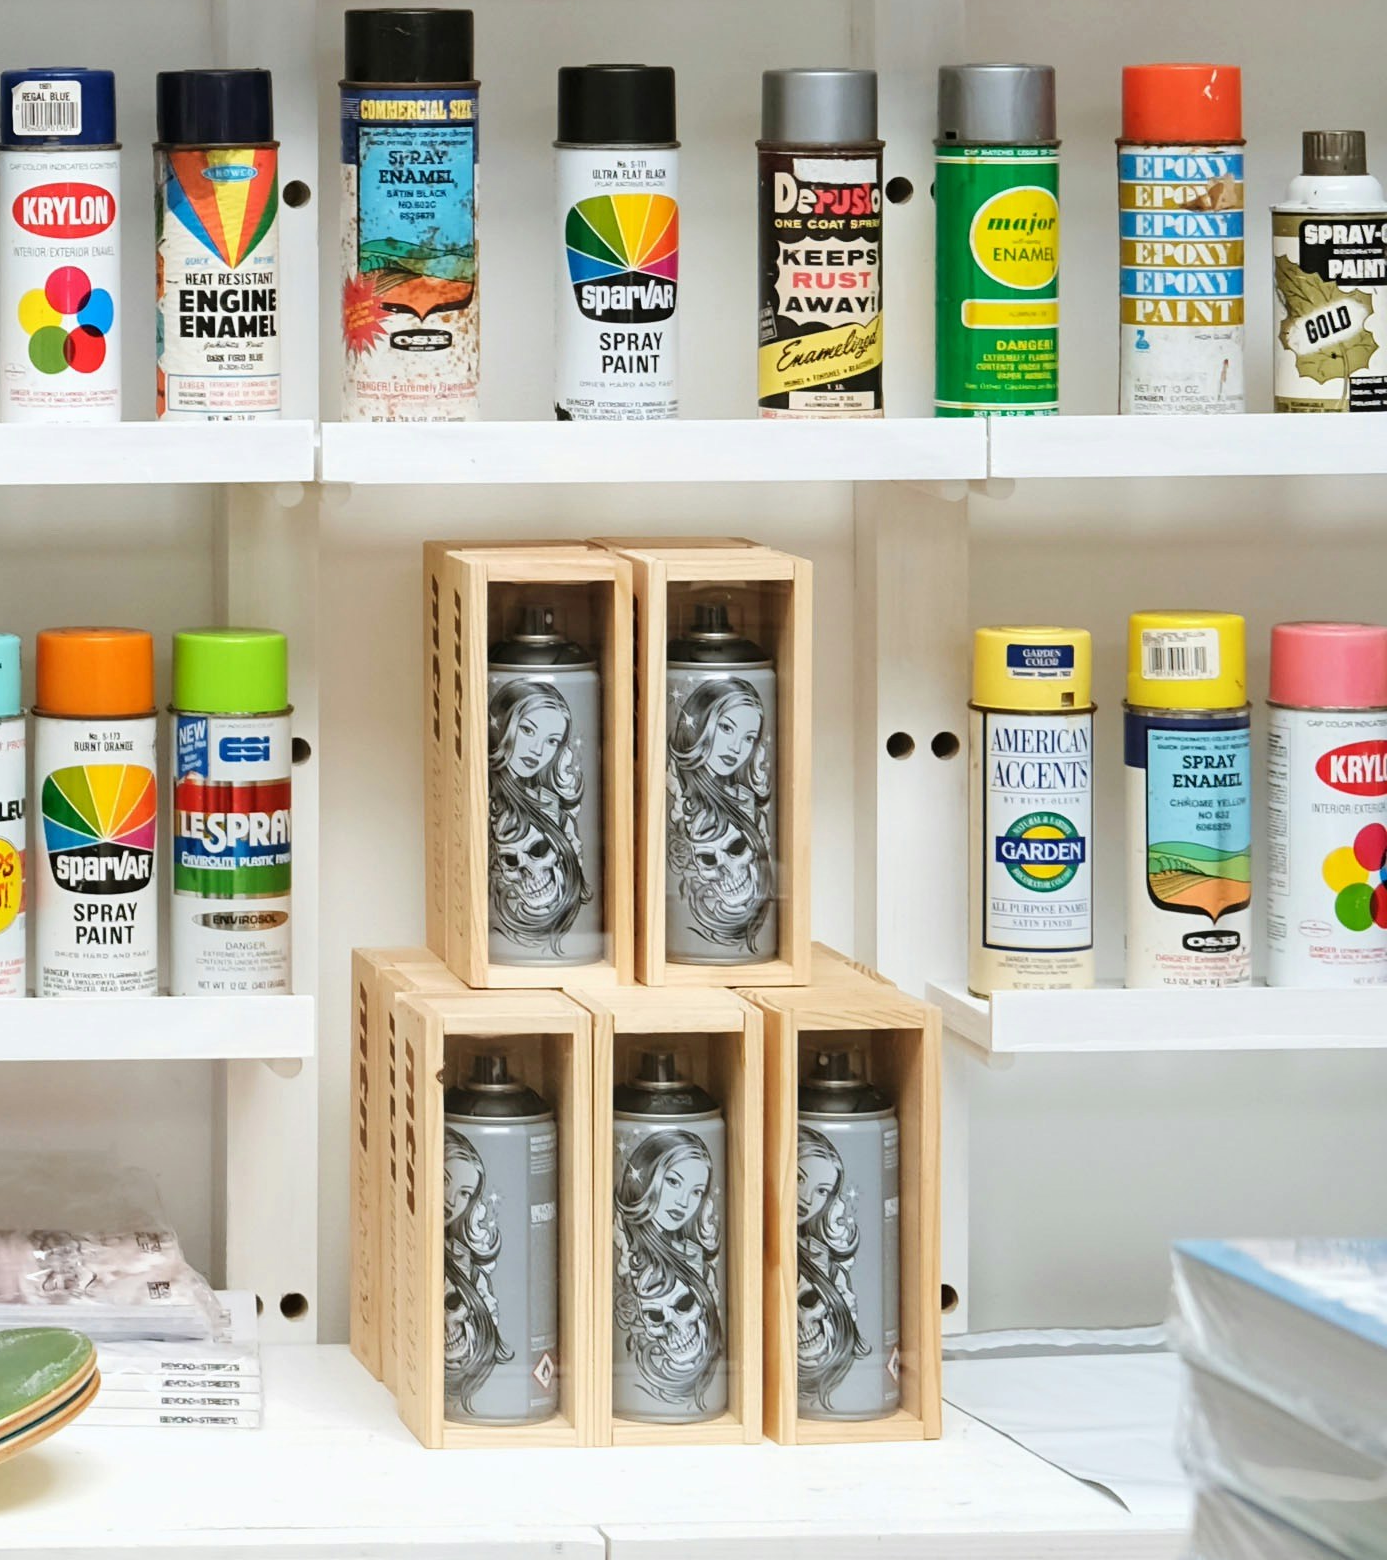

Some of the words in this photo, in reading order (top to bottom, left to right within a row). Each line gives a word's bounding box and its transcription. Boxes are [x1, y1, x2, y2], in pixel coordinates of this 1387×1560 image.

[22, 91, 45, 102] REGAL
[49, 91, 71, 101] BLUE
[359, 98, 444, 120] COMMERCIAL
[592, 169, 618, 179] ULTRA
[621, 169, 641, 179] FLAT
[645, 169, 667, 179] BLACK
[988, 211, 1056, 235] major
[782, 249, 878, 266] KEEPS
[186, 272, 214, 285] HEAT
[218, 272, 272, 285] RESISTANT
[1304, 305, 1352, 343] GOLD
[996, 339, 1053, 351] DANGER!
[74, 741, 101, 752] BURNT
[1182, 753, 1235, 769] SPRAY
[1002, 841, 1082, 860] GARDEN
[212, 914, 277, 925] ENVIROSOL
